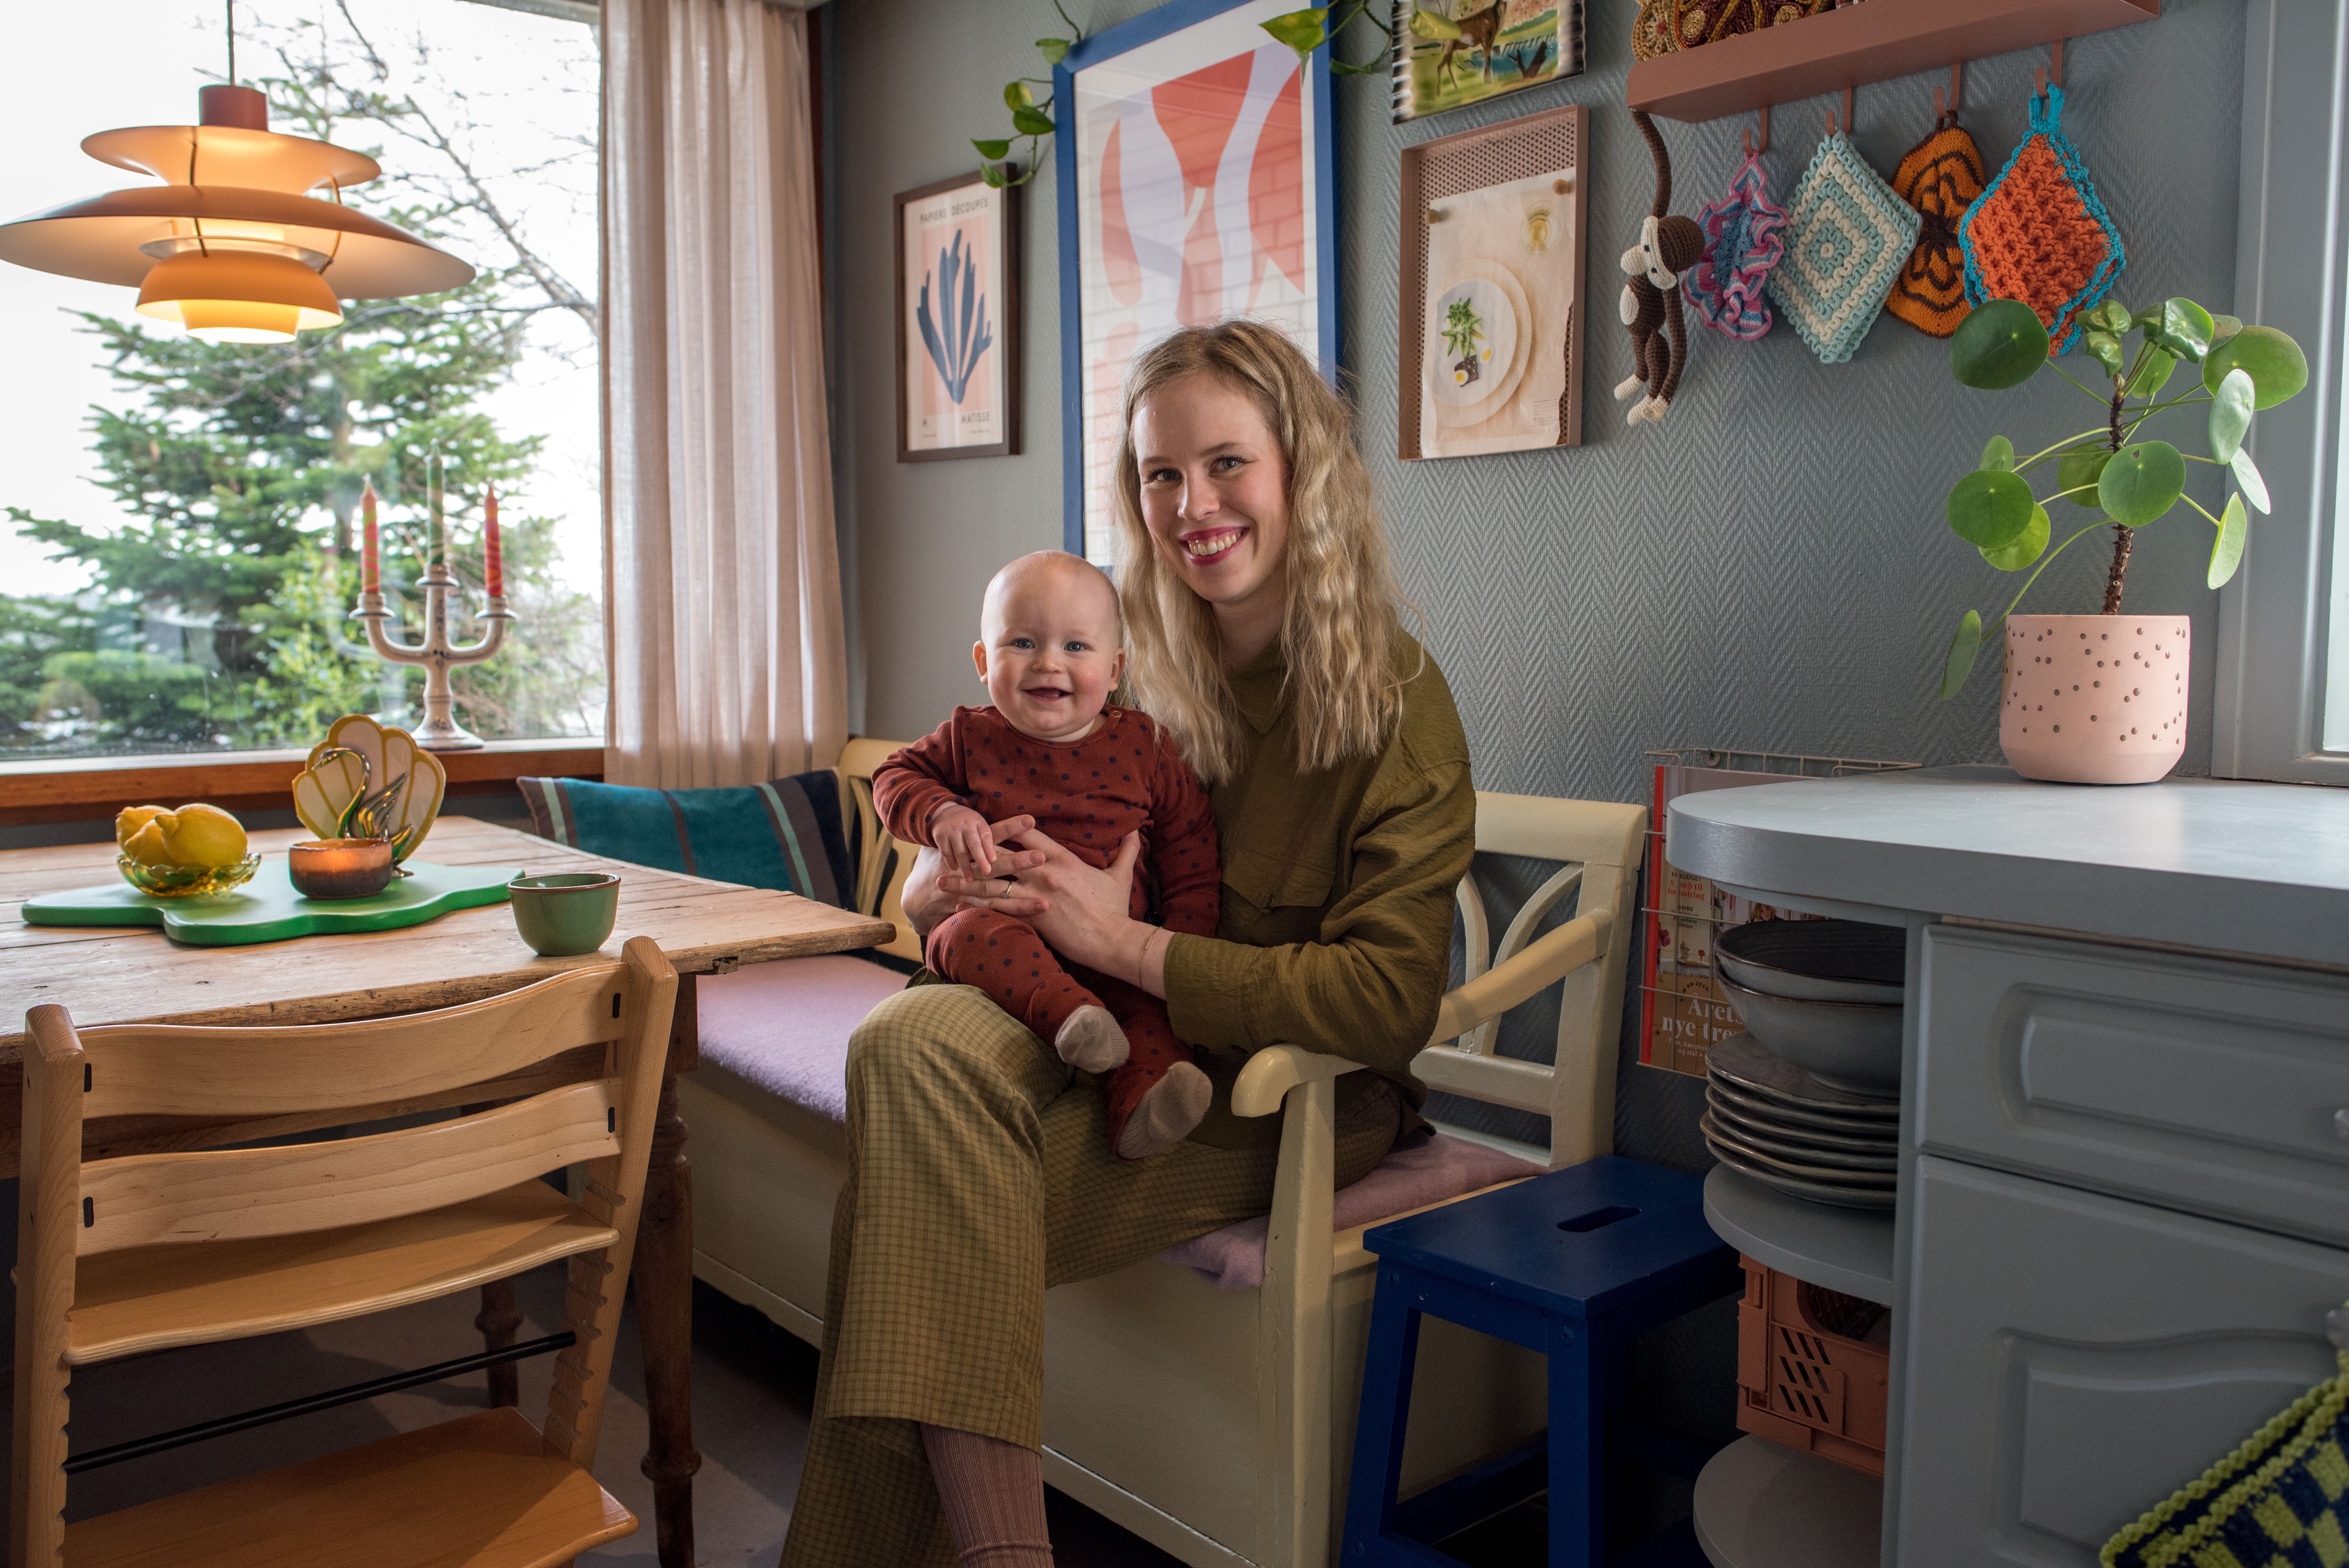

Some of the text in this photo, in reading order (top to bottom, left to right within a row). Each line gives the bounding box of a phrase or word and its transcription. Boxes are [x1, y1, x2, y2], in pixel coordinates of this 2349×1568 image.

[961, 411, 990, 423] MATISSE
[1679, 873, 1701, 881] BUDGET
[1662, 1017, 1738, 1041] nye tre
[1668, 1037, 1682, 1047] Trn,
